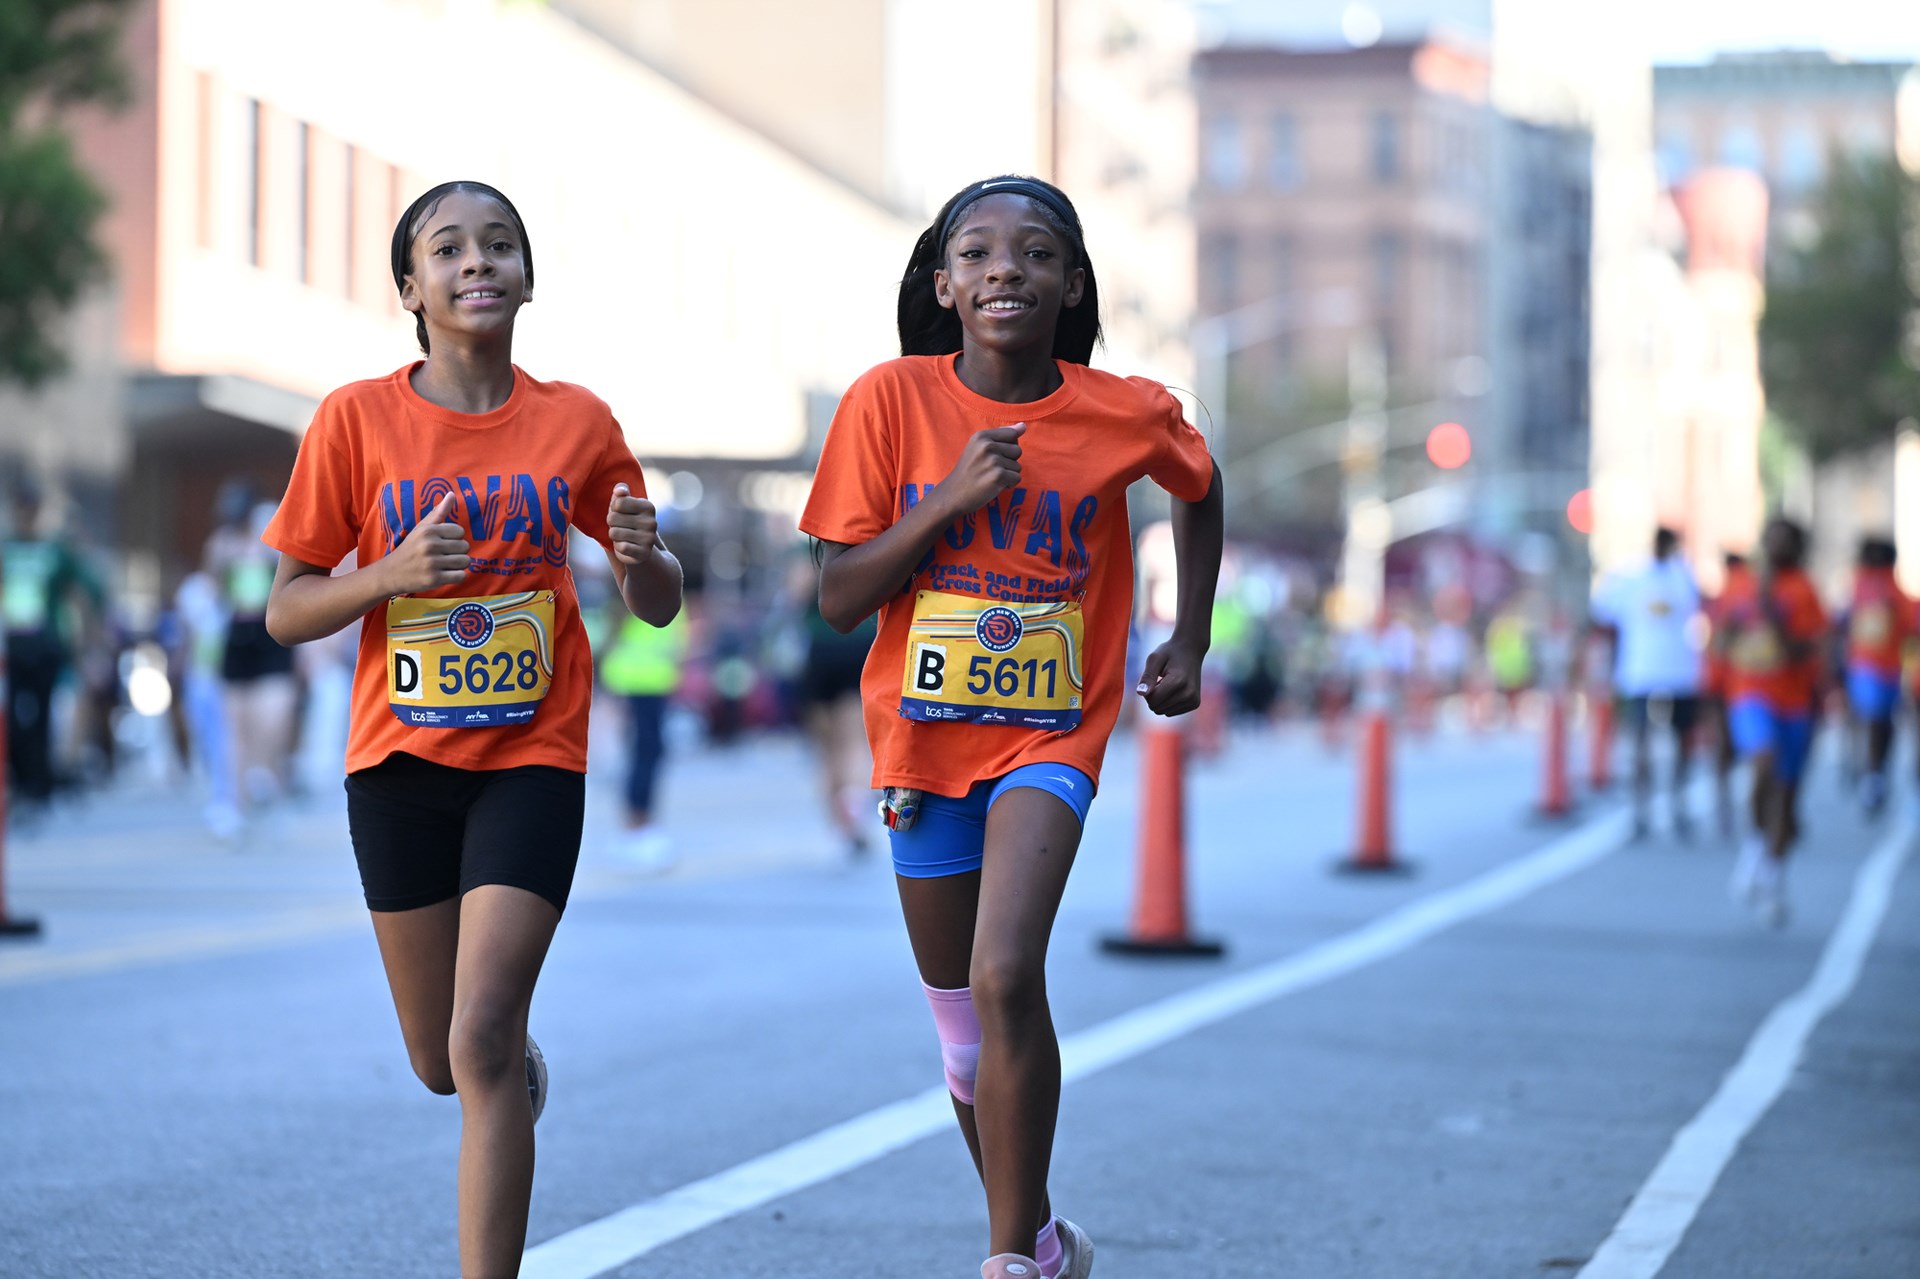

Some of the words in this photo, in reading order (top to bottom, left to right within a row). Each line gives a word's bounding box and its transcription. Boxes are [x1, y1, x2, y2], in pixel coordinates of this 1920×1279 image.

[378, 474, 570, 568] NOVAS
[471, 556, 498, 565] and
[503, 555, 542, 567] Field
[469, 564, 536, 576] Country
[928, 563, 980, 580] Track
[985, 571, 1021, 589] and
[1027, 576, 1071, 593] Field
[932, 577, 981, 593] Cross
[480, 608, 491, 623] YORK
[980, 610, 996, 626] RISING
[1010, 614, 1020, 629] YORK
[452, 631, 466, 645] ROAD
[980, 633, 993, 647] ROAD
[395, 653, 418, 693] D
[439, 650, 539, 695] 5628
[917, 649, 945, 691] B
[967, 655, 1057, 699] 5611
[411, 710, 426, 722] tcs
[926, 705, 942, 718] tcs
